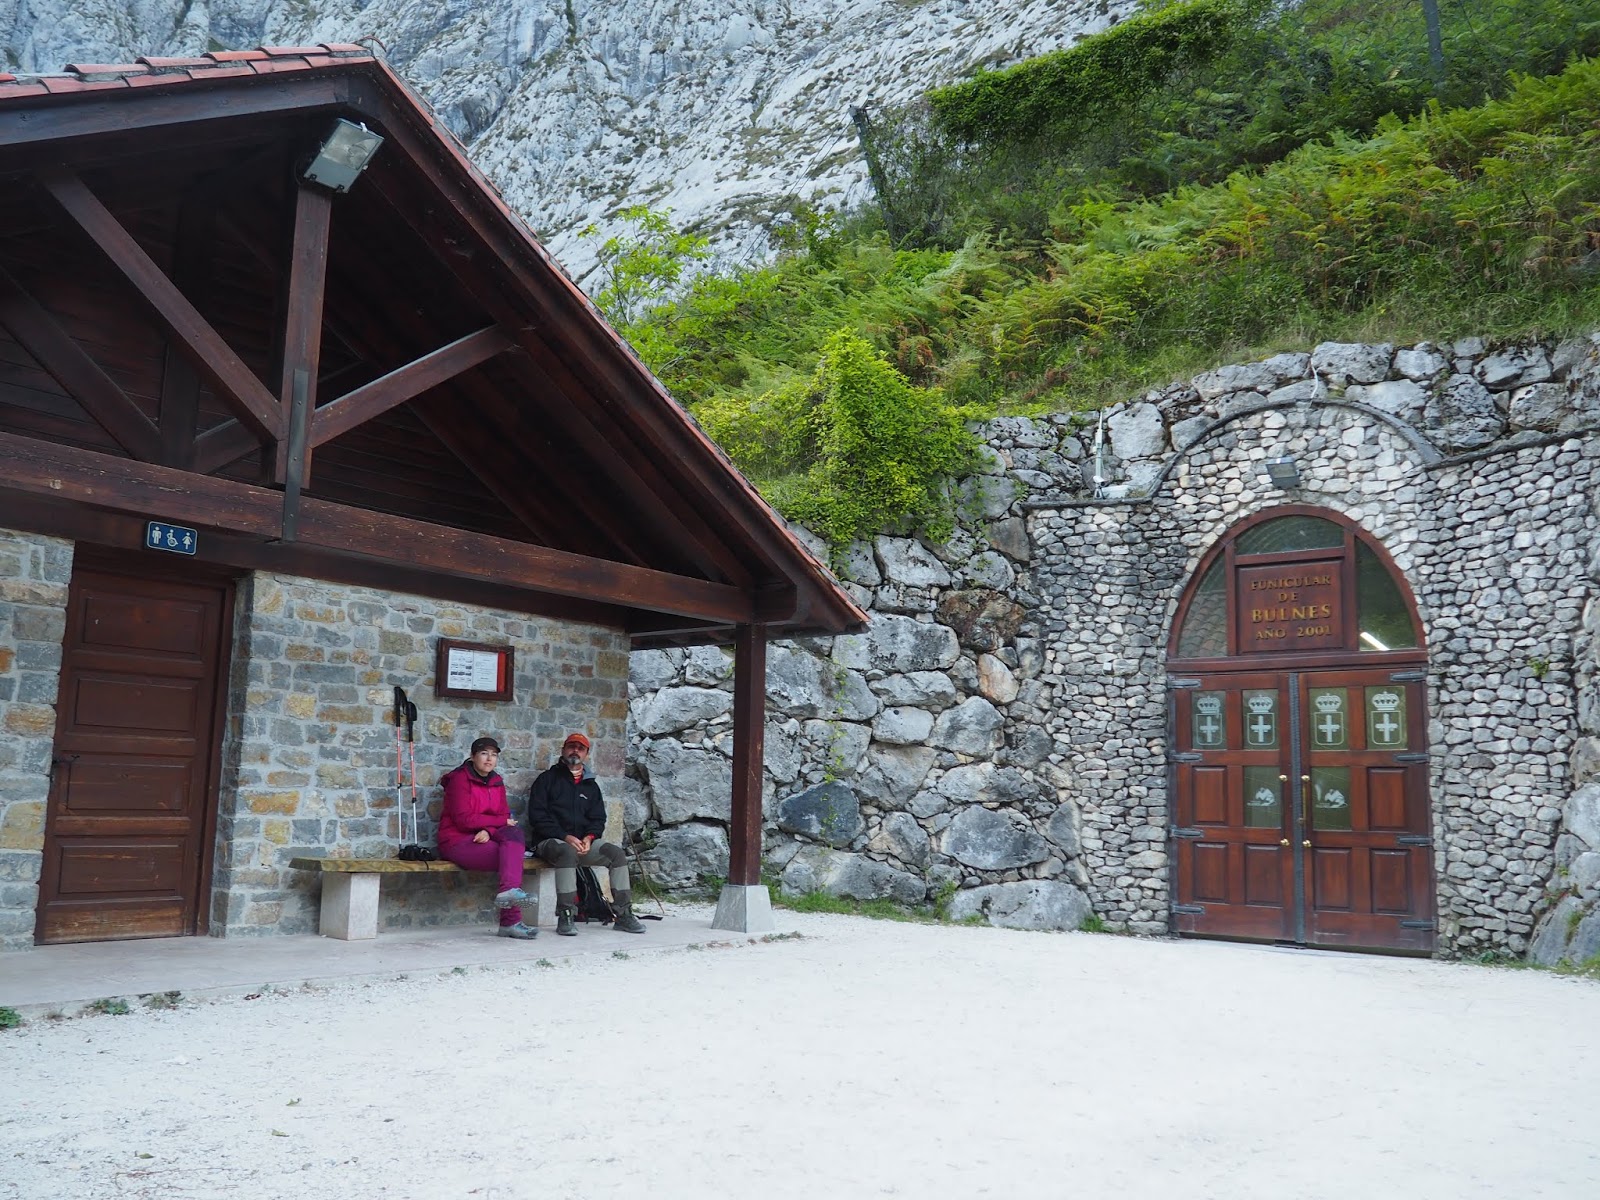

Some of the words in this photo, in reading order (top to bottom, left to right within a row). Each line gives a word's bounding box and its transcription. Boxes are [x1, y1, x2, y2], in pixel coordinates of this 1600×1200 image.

[1251, 575, 1331, 590] FUNICULAR
[1278, 592, 1298, 603] DE
[1252, 604, 1331, 623] BULNES
[1256, 626, 1287, 640] AÑO
[1297, 625, 1332, 638] 2001
